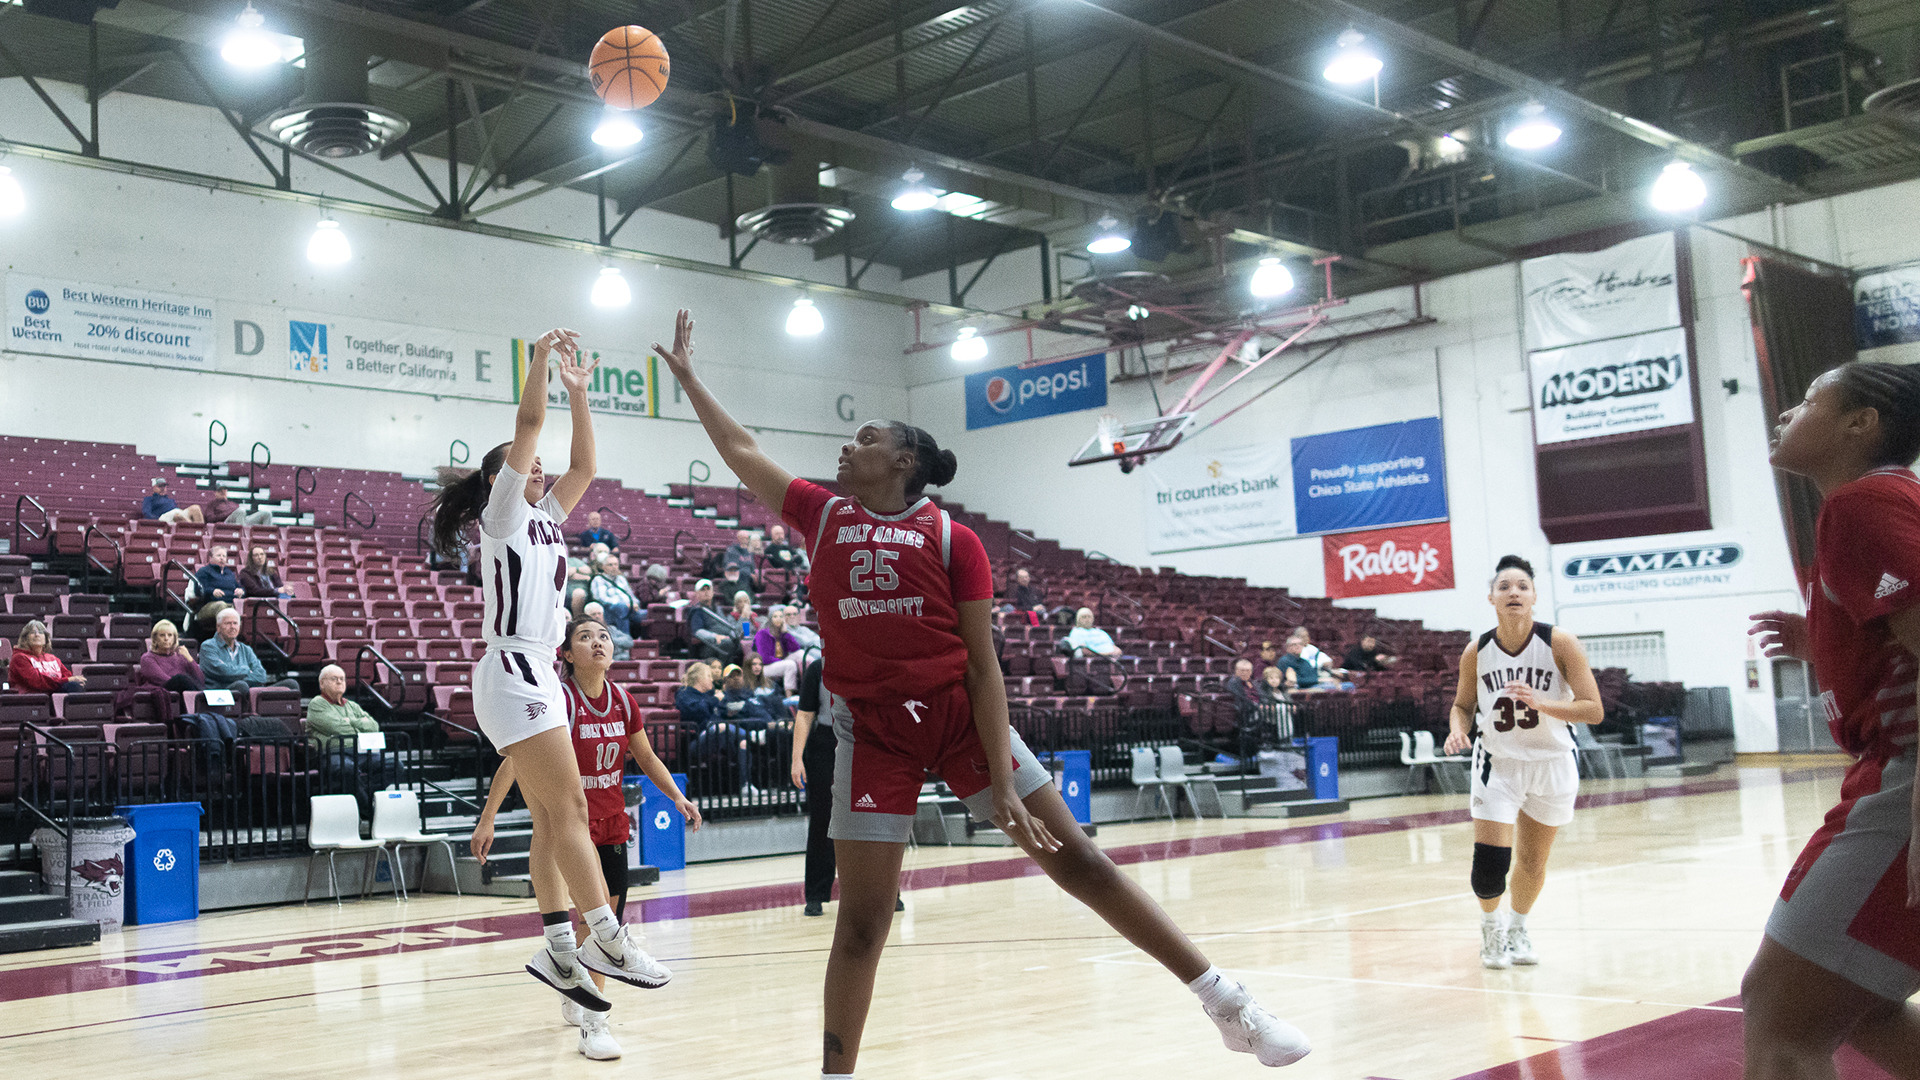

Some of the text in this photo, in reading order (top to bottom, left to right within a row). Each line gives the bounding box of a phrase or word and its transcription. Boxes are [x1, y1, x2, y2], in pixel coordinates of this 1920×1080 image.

[28, 296, 48, 309] BW
[63, 288, 212, 318] Best Western Heritage Inn
[12, 327, 62, 342] Western
[25, 316, 50, 329] Best
[87, 323, 191, 347] 20% discount
[233, 320, 265, 356] D
[345, 335, 453, 363] Together, Building
[290, 350, 328, 372] PG&E
[346, 357, 457, 381] a Better California
[1020, 363, 1088, 404] pepsi
[1541, 354, 1682, 409] MODERN
[612, 397, 646, 413] Transit
[1310, 456, 1426, 481] Proudly supporting
[1157, 474, 1279, 504] tri counties bank
[1309, 472, 1430, 498] Chico State Athletics
[836, 524, 925, 548] HOLY NAMES
[850, 549, 899, 591] 25
[1339, 540, 1439, 585] Raley's
[1577, 549, 1724, 575] LAMAR
[1573, 574, 1731, 594] ADVERTISING COMPANY
[1874, 579, 1909, 599] adidas
[1492, 697, 1539, 732] 33
[579, 723, 602, 739] HOLY
[596, 742, 620, 771] 10
[87, 900, 112, 908] FIELD
[101, 926, 503, 974] NCAA
